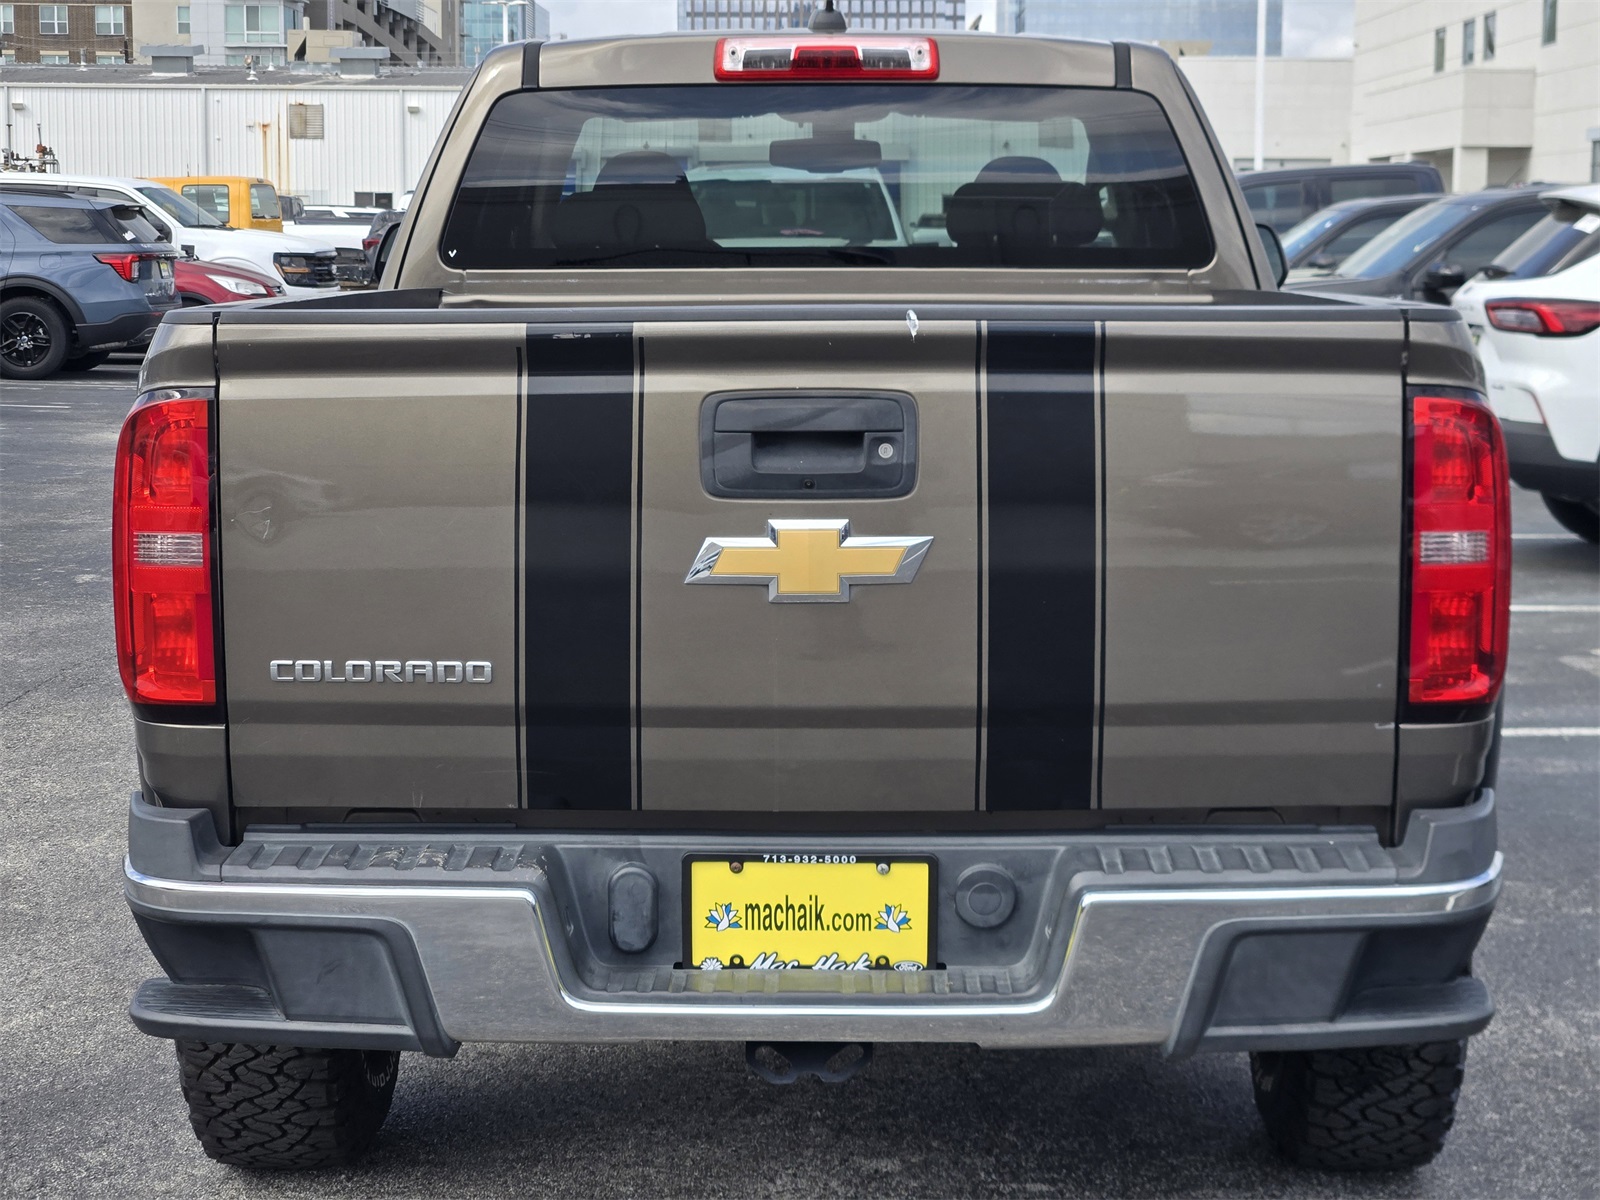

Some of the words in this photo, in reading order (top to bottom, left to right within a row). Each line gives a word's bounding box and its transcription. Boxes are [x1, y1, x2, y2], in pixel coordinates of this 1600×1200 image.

[269, 659, 493, 684] COLORADO
[763, 854, 857, 864] 713-932-5000
[744, 894, 872, 932] machaik.com
